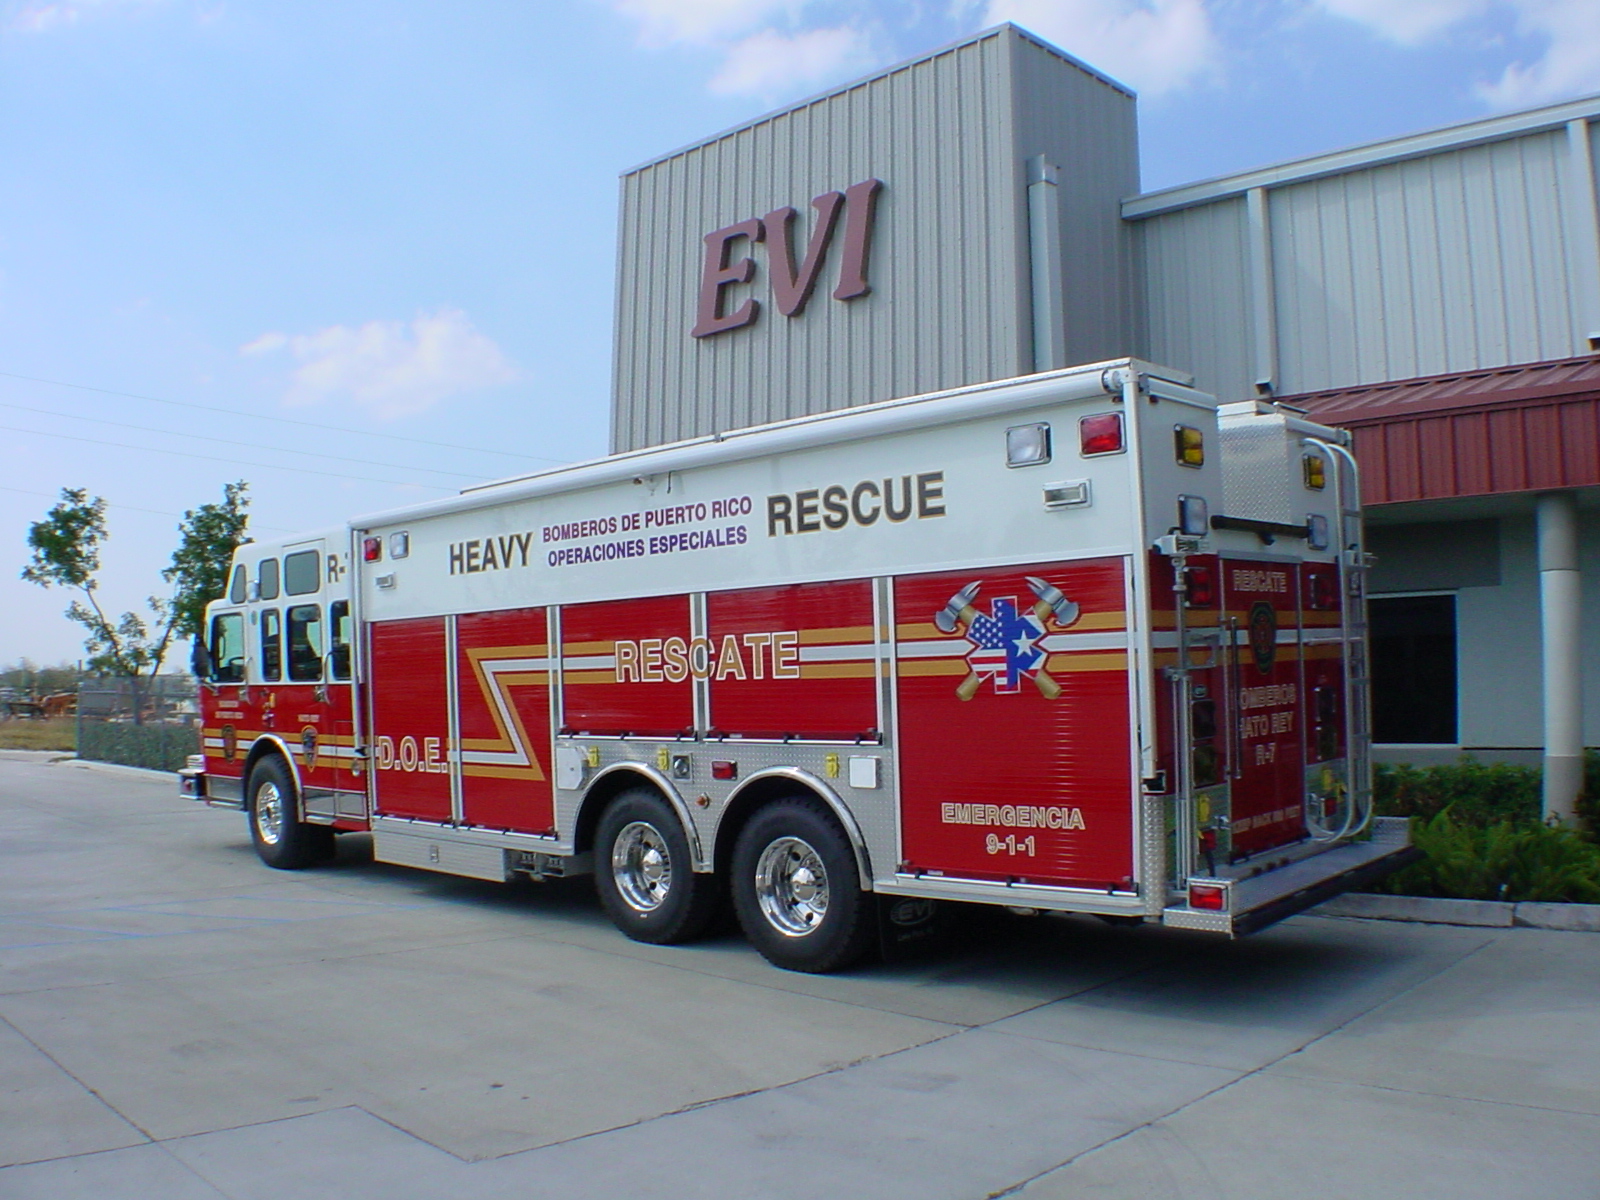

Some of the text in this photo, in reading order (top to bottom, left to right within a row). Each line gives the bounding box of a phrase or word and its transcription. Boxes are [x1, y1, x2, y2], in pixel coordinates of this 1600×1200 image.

[691, 178, 883, 339] EVI
[543, 496, 752, 543] BOMBEROS DE PUERTO RICO
[767, 470, 946, 537] RESCUE
[450, 531, 533, 575] HEAVY
[548, 525, 748, 568] OPERACIONES ESPECIALES
[327, 552, 349, 584] R-
[1232, 569, 1287, 592] RESCATE
[615, 631, 800, 682] RESCATE
[1239, 683, 1297, 710] OMBEROS
[378, 735, 448, 773] D.O.E.
[941, 802, 1086, 830] EMERGENCIA
[986, 833, 1036, 856] 9-1-1
